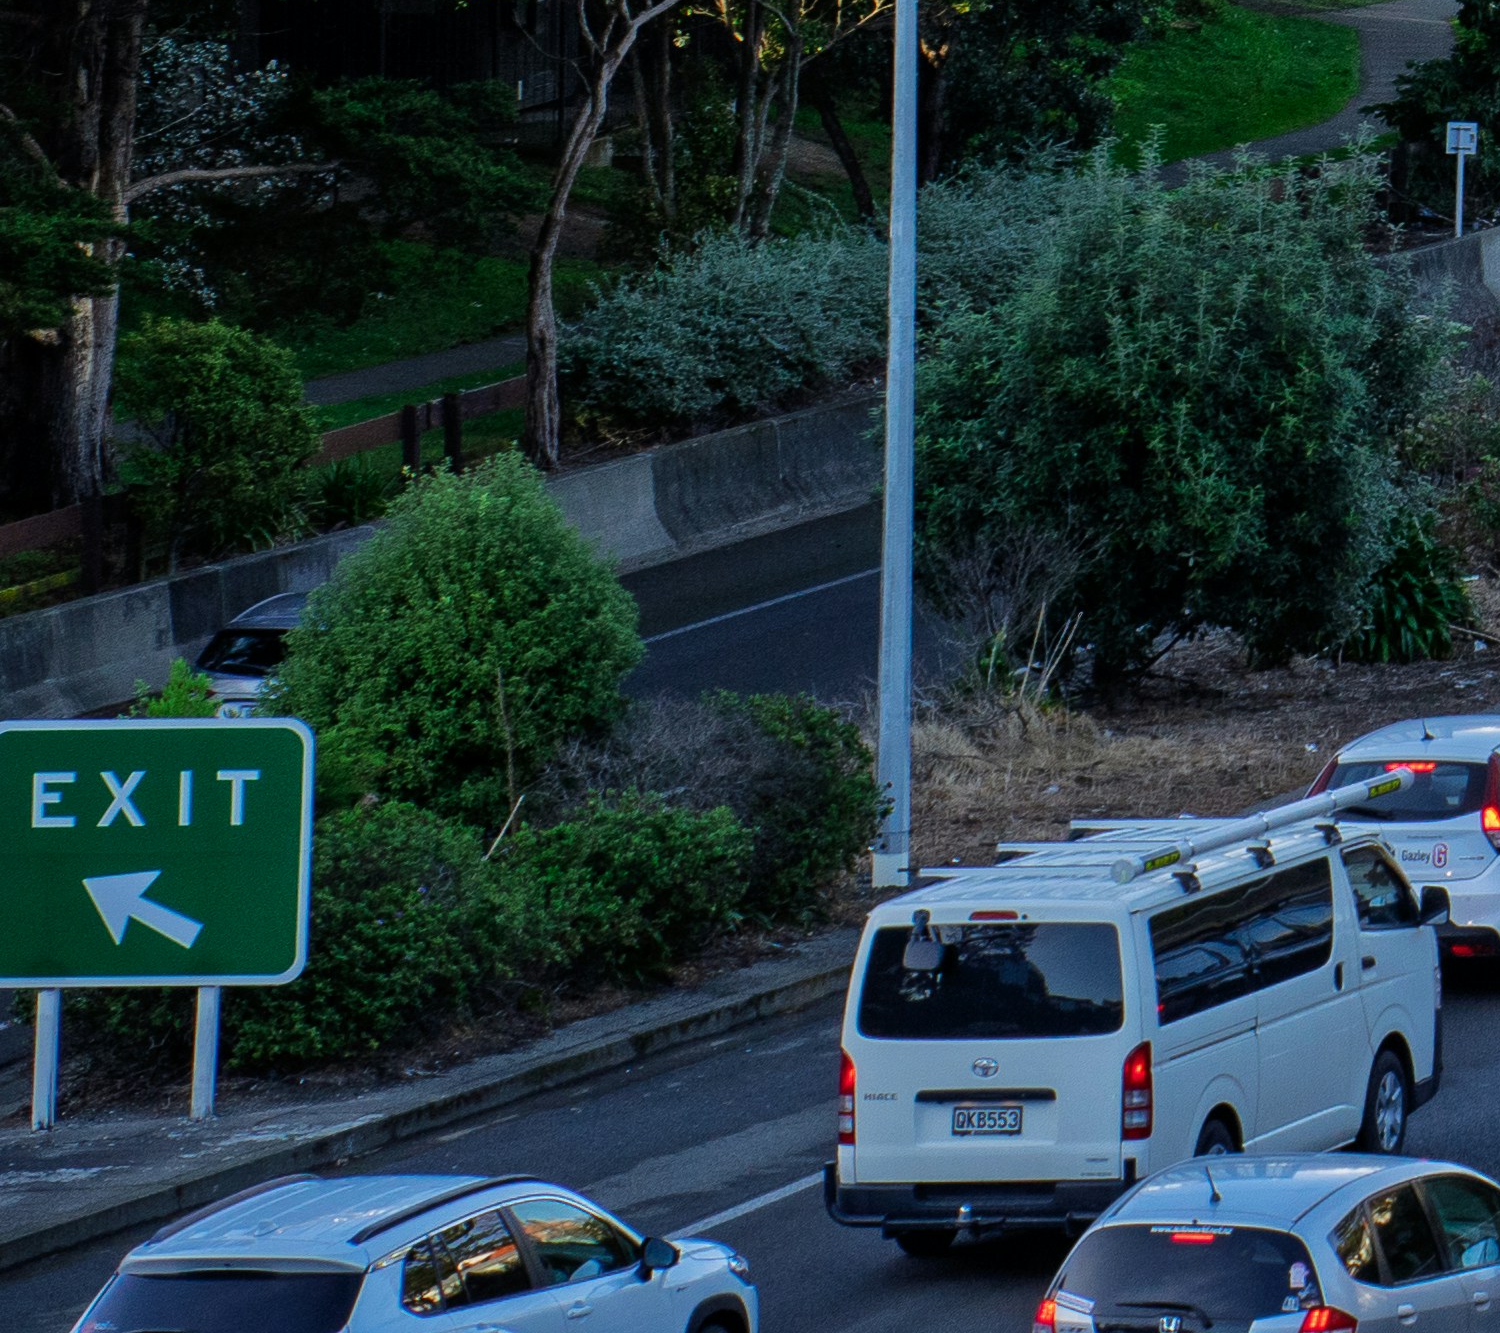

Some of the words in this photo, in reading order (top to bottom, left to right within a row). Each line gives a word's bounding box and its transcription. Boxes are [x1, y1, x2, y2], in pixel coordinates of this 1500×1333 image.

[31, 770, 261, 828] EXIT
[1401, 849, 1432, 864] Gazley
[955, 1110, 1020, 1130] QKB553
